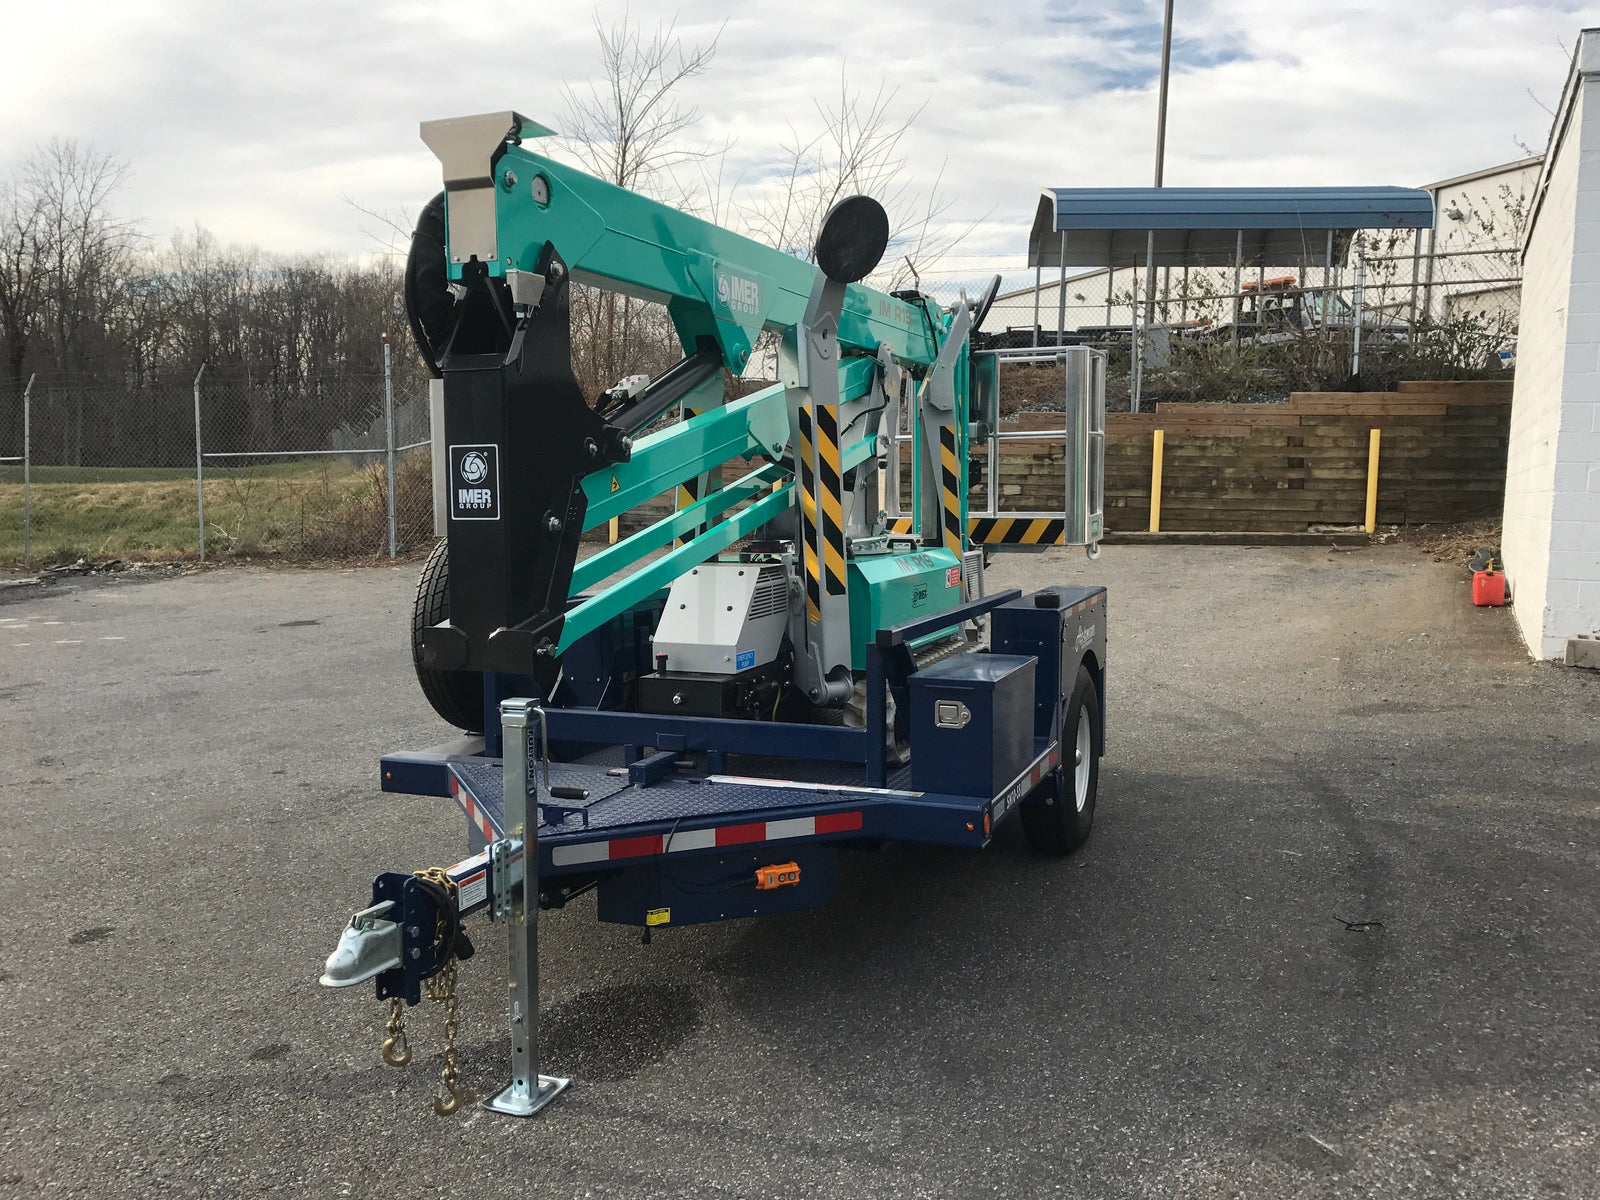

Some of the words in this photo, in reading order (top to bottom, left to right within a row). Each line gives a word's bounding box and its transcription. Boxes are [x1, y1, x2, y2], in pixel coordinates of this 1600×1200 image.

[731, 275, 759, 307] IMER
[731, 300, 760, 315] GROUP
[879, 300, 891, 319] IM
[895, 305, 912, 325] R19
[458, 489, 492, 503] IMER
[894, 558, 914, 574] IM
[910, 553, 935, 570] R19
[527, 729, 535, 780] FULTON
